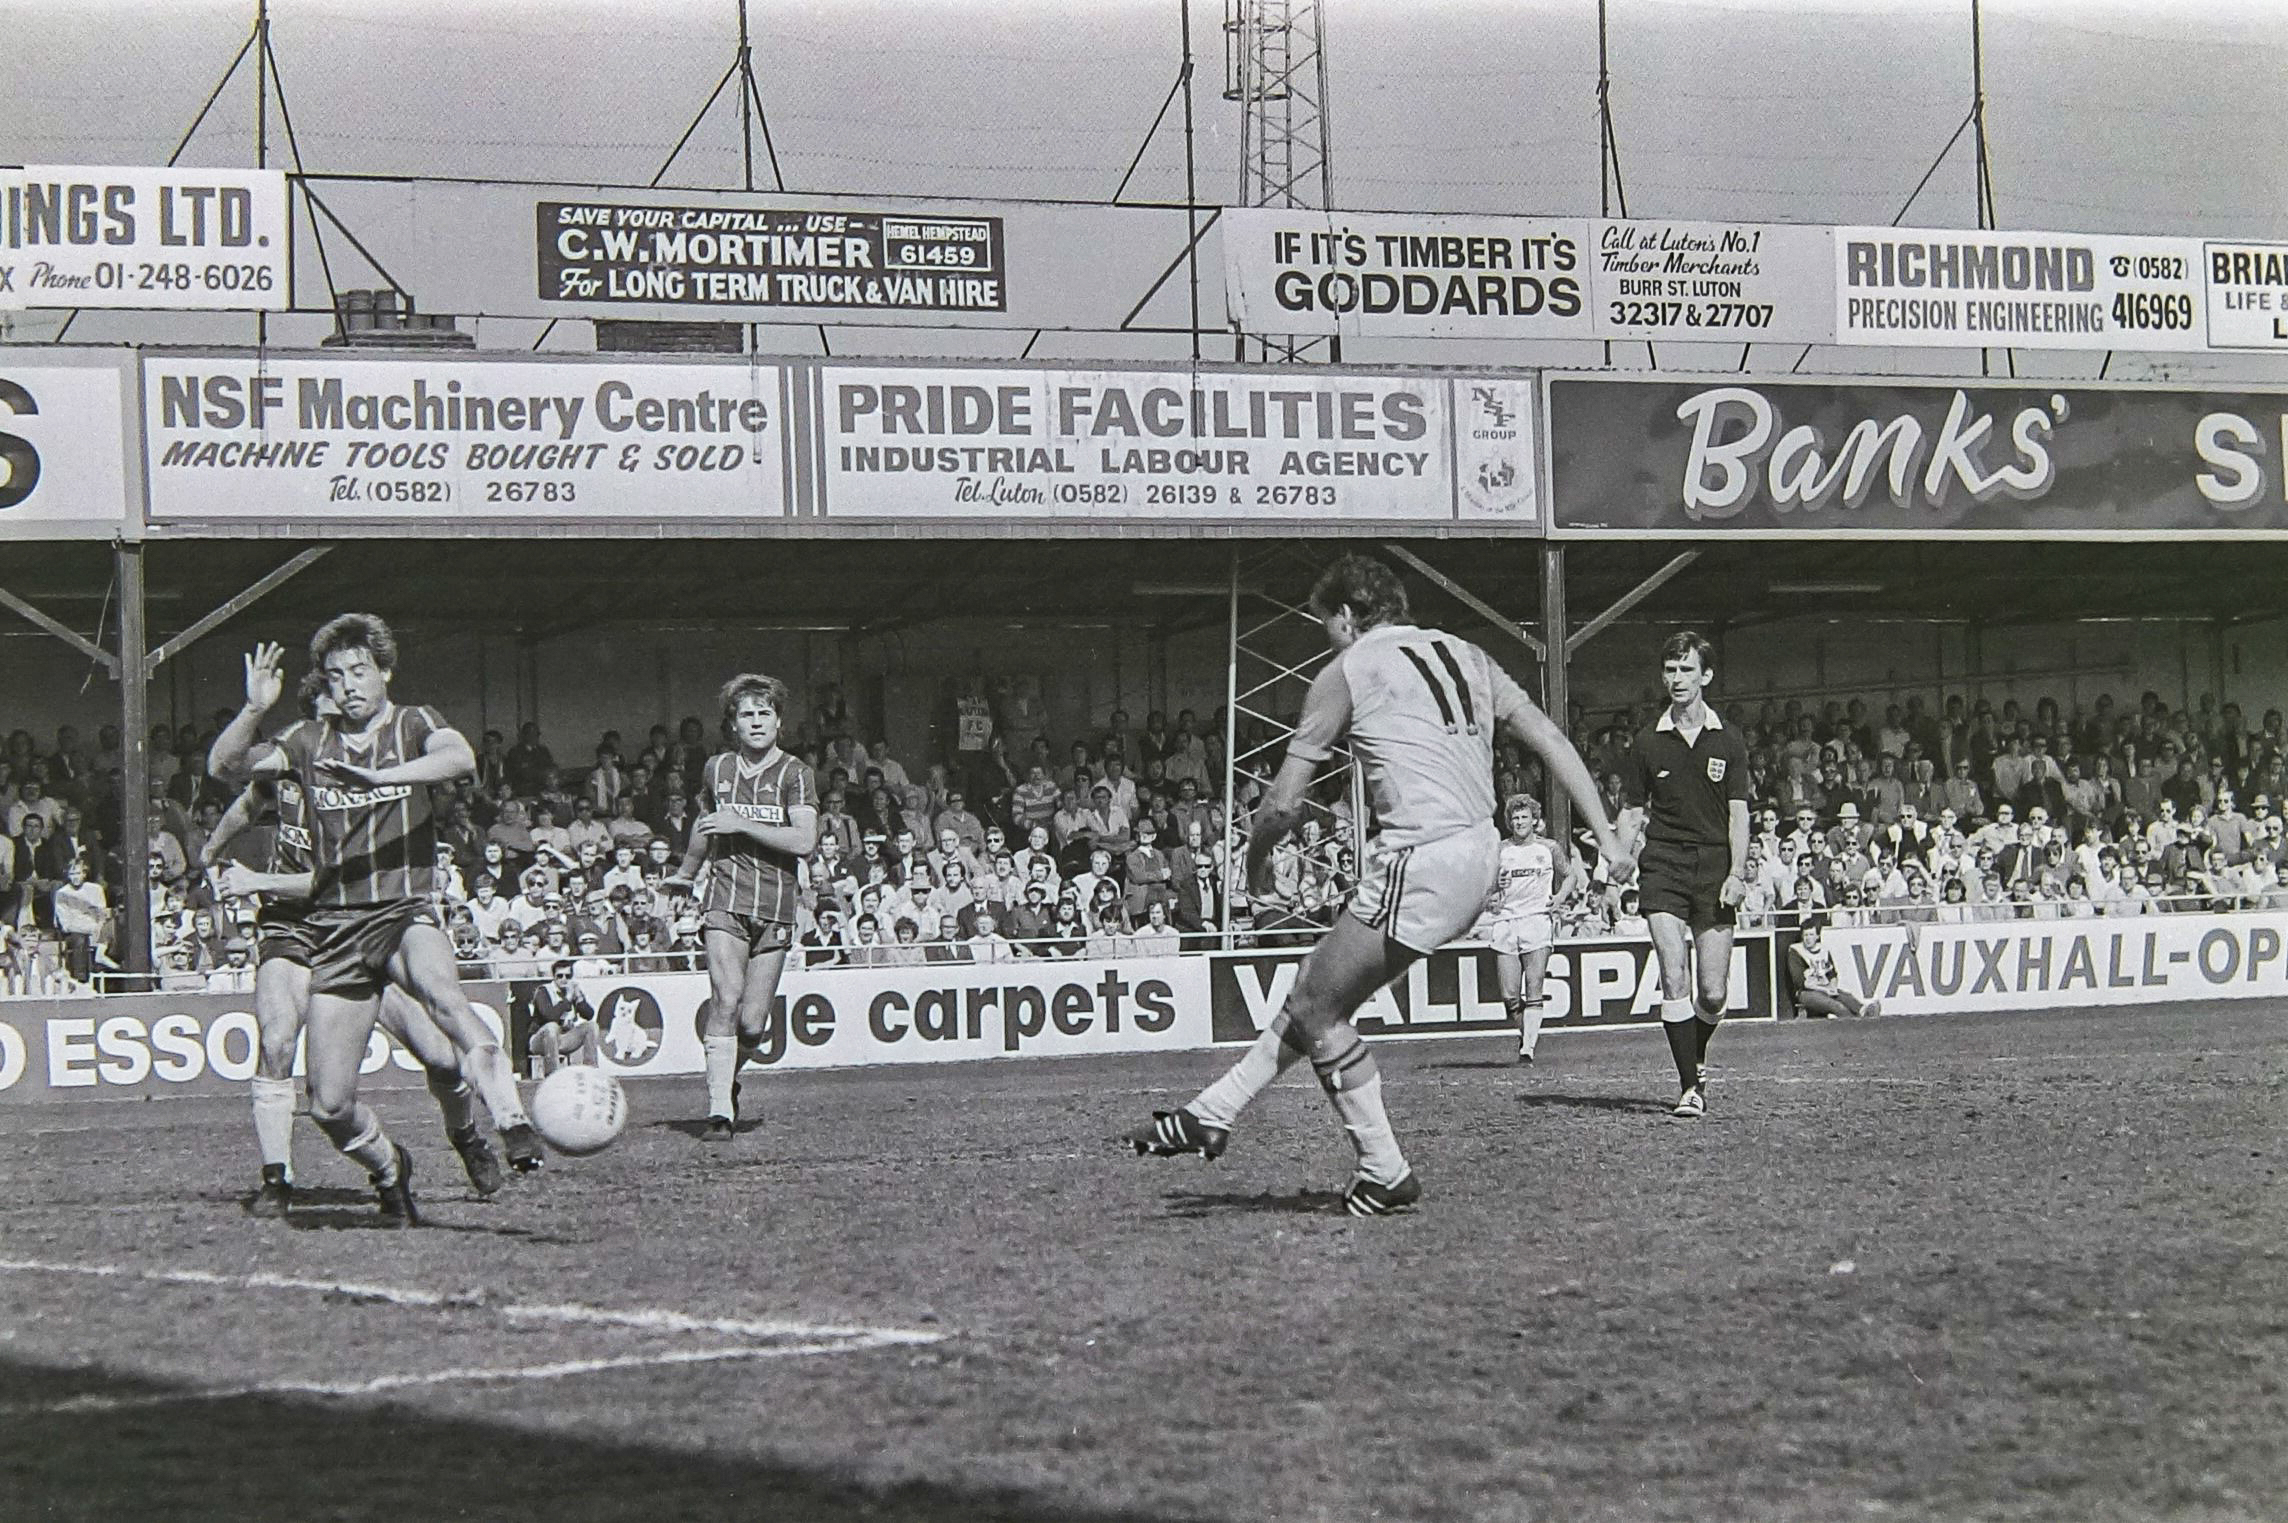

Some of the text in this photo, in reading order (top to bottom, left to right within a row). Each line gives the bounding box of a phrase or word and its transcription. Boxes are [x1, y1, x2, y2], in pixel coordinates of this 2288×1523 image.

[0, 183, 269, 249] INGS LTD.
[558, 207, 611, 226] SAVE
[617, 209, 673, 228] YOUR
[682, 212, 768, 231] CAPITAL
[887, 224, 986, 242] HEMEL HEMPSTEAD
[1274, 227, 1576, 271] IF IT'S TIMBER IT'S
[1601, 226, 1761, 253] Call at Luton's No.1
[901, 245, 976, 265] 61459
[1601, 251, 1760, 276] Timber Merchants
[1847, 242, 2094, 292] RICHMOND
[2132, 256, 2189, 280] (0582)
[2212, 252, 2288, 286] BRIA
[30, 261, 91, 289] Phone
[559, 268, 602, 298] For
[608, 269, 685, 299] LONG
[691, 272, 769, 301] TERM
[776, 274, 863, 304] TRUCK
[883, 276, 934, 305] VAN
[939, 278, 999, 307] HIRE
[1620, 279, 1662, 296] BURR
[1693, 281, 1741, 298] LUTON
[1274, 270, 1582, 317] GODDARDS
[2225, 291, 2271, 310] LIFE
[1609, 301, 1682, 326] 32317
[1705, 303, 1774, 328] 27707
[1848, 298, 2103, 332] PRECISION ENGINEERING
[2112, 292, 2192, 330] 416969
[161, 375, 768, 440] NSF Machinery Centre
[839, 384, 1427, 441] PRIDE FACILITIES
[1473, 430, 1517, 440] GROUP
[161, 440, 744, 473] MACHINE TOOLS BOUGHT & SOLD
[841, 446, 1429, 477] INDUSTRIAL LABOUR AGENCY
[2195, 412, 2288, 502] S
[329, 474, 576, 502] Tel. (0582) 26783
[1054, 483, 1128, 504] (0582)
[1146, 484, 1217, 505] 26139
[1229, 487, 1243, 505] &
[1256, 486, 1337, 506] 26783
[1399, 641, 1478, 736] 11
[1851, 927, 2288, 999] VAUXHALL-OP
[868, 969, 1176, 1051] carpets
[47, 1011, 260, 1087] ESSO
